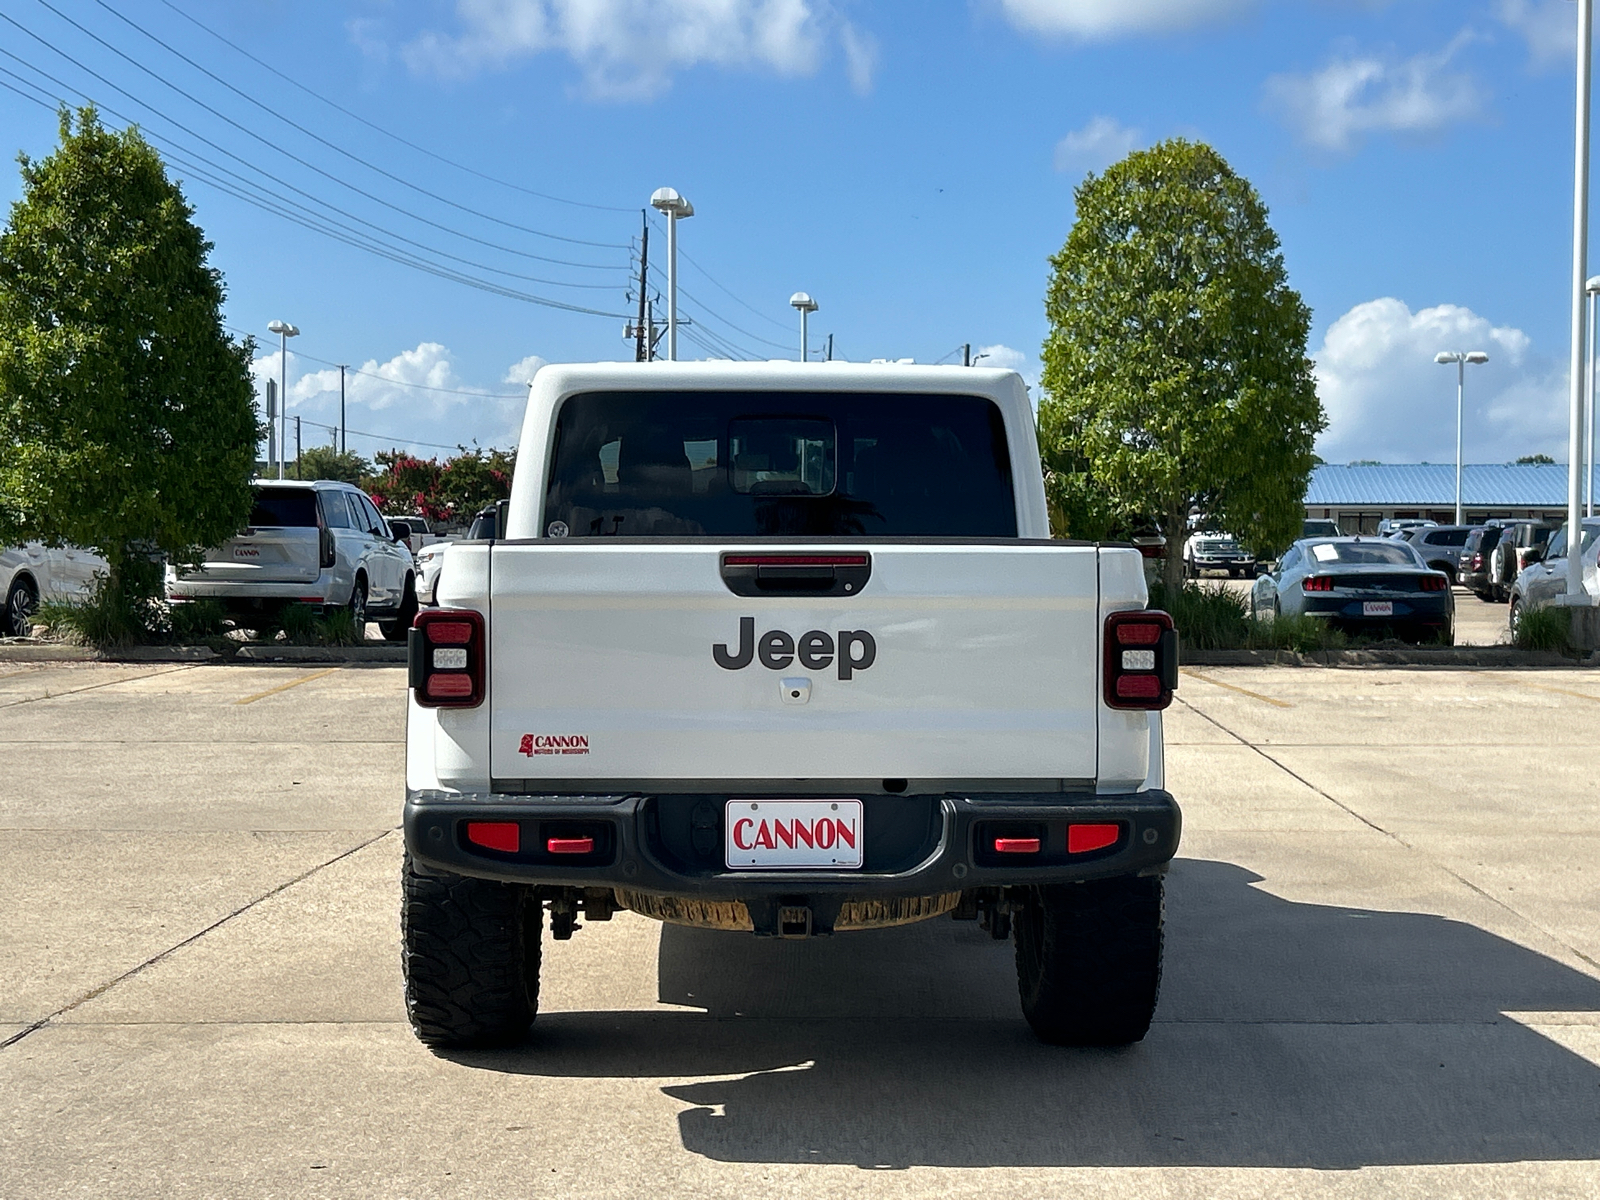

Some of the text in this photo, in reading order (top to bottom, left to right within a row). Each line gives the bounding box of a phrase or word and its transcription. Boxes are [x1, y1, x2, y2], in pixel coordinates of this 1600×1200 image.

[712, 617, 877, 680] Jeep
[535, 735, 588, 748] CANNON
[733, 817, 856, 850] CANNON
